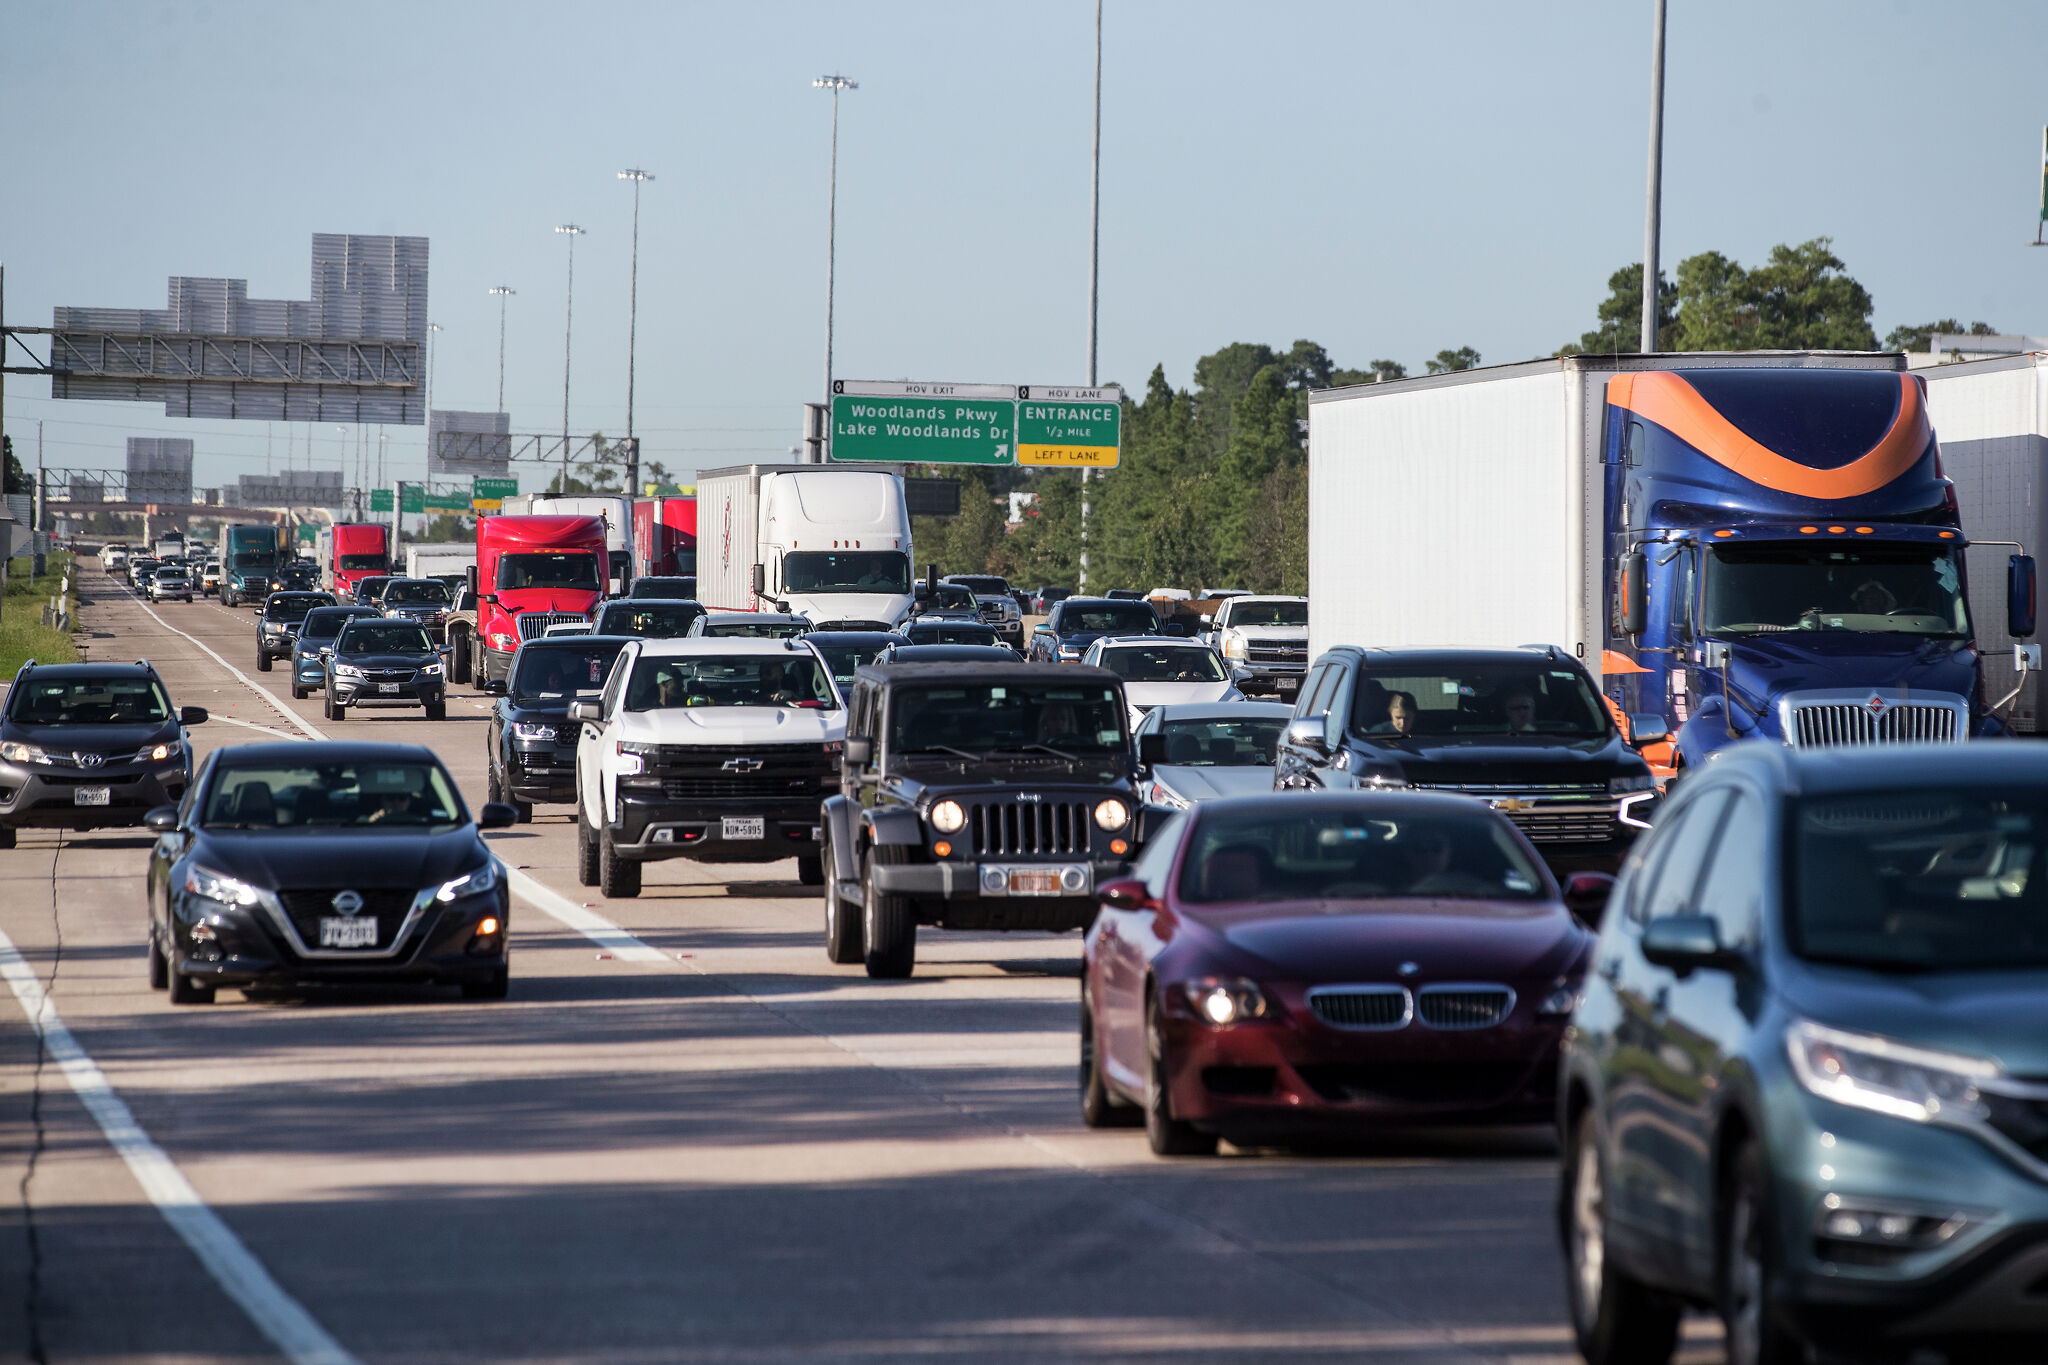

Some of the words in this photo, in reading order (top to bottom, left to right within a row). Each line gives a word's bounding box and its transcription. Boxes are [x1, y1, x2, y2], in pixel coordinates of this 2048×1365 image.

[906, 385, 927, 394] HOV
[1049, 389, 1070, 398] HOV
[1075, 391, 1102, 399] LANE
[851, 404, 946, 420] Woodlands
[955, 407, 998, 424] Pkwy
[1025, 406, 1113, 422] ENTRANCE
[838, 423, 877, 436] Lake
[886, 423, 981, 439] Woodlands
[990, 426, 1009, 439] Dr
[1067, 427, 1092, 437] MILE
[1035, 450, 1062, 460] LEFT
[1069, 451, 1101, 461] LANE
